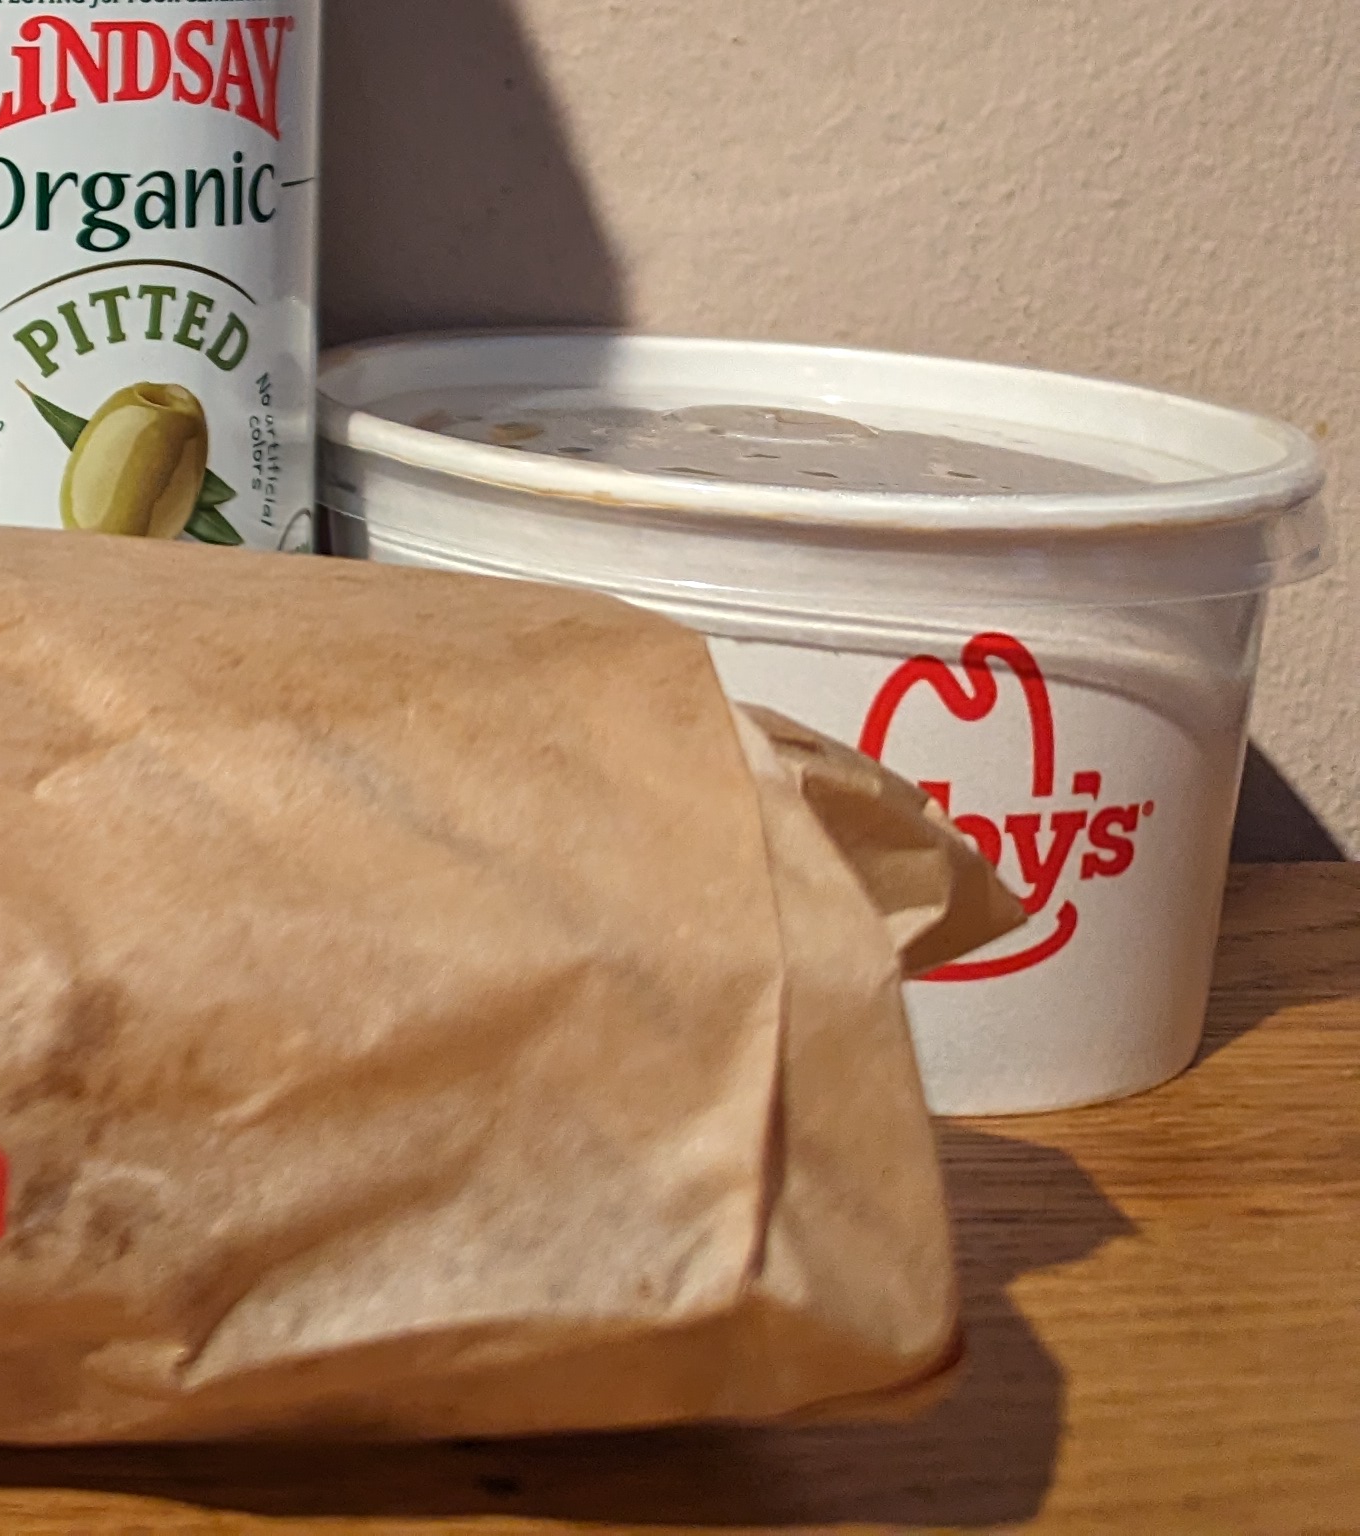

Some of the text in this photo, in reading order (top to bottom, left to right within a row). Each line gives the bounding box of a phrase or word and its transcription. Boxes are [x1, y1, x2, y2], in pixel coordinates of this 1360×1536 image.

[12, 284, 250, 378] PITTED
[249, 415, 266, 490] colors
[256, 372, 280, 527] No artificial
